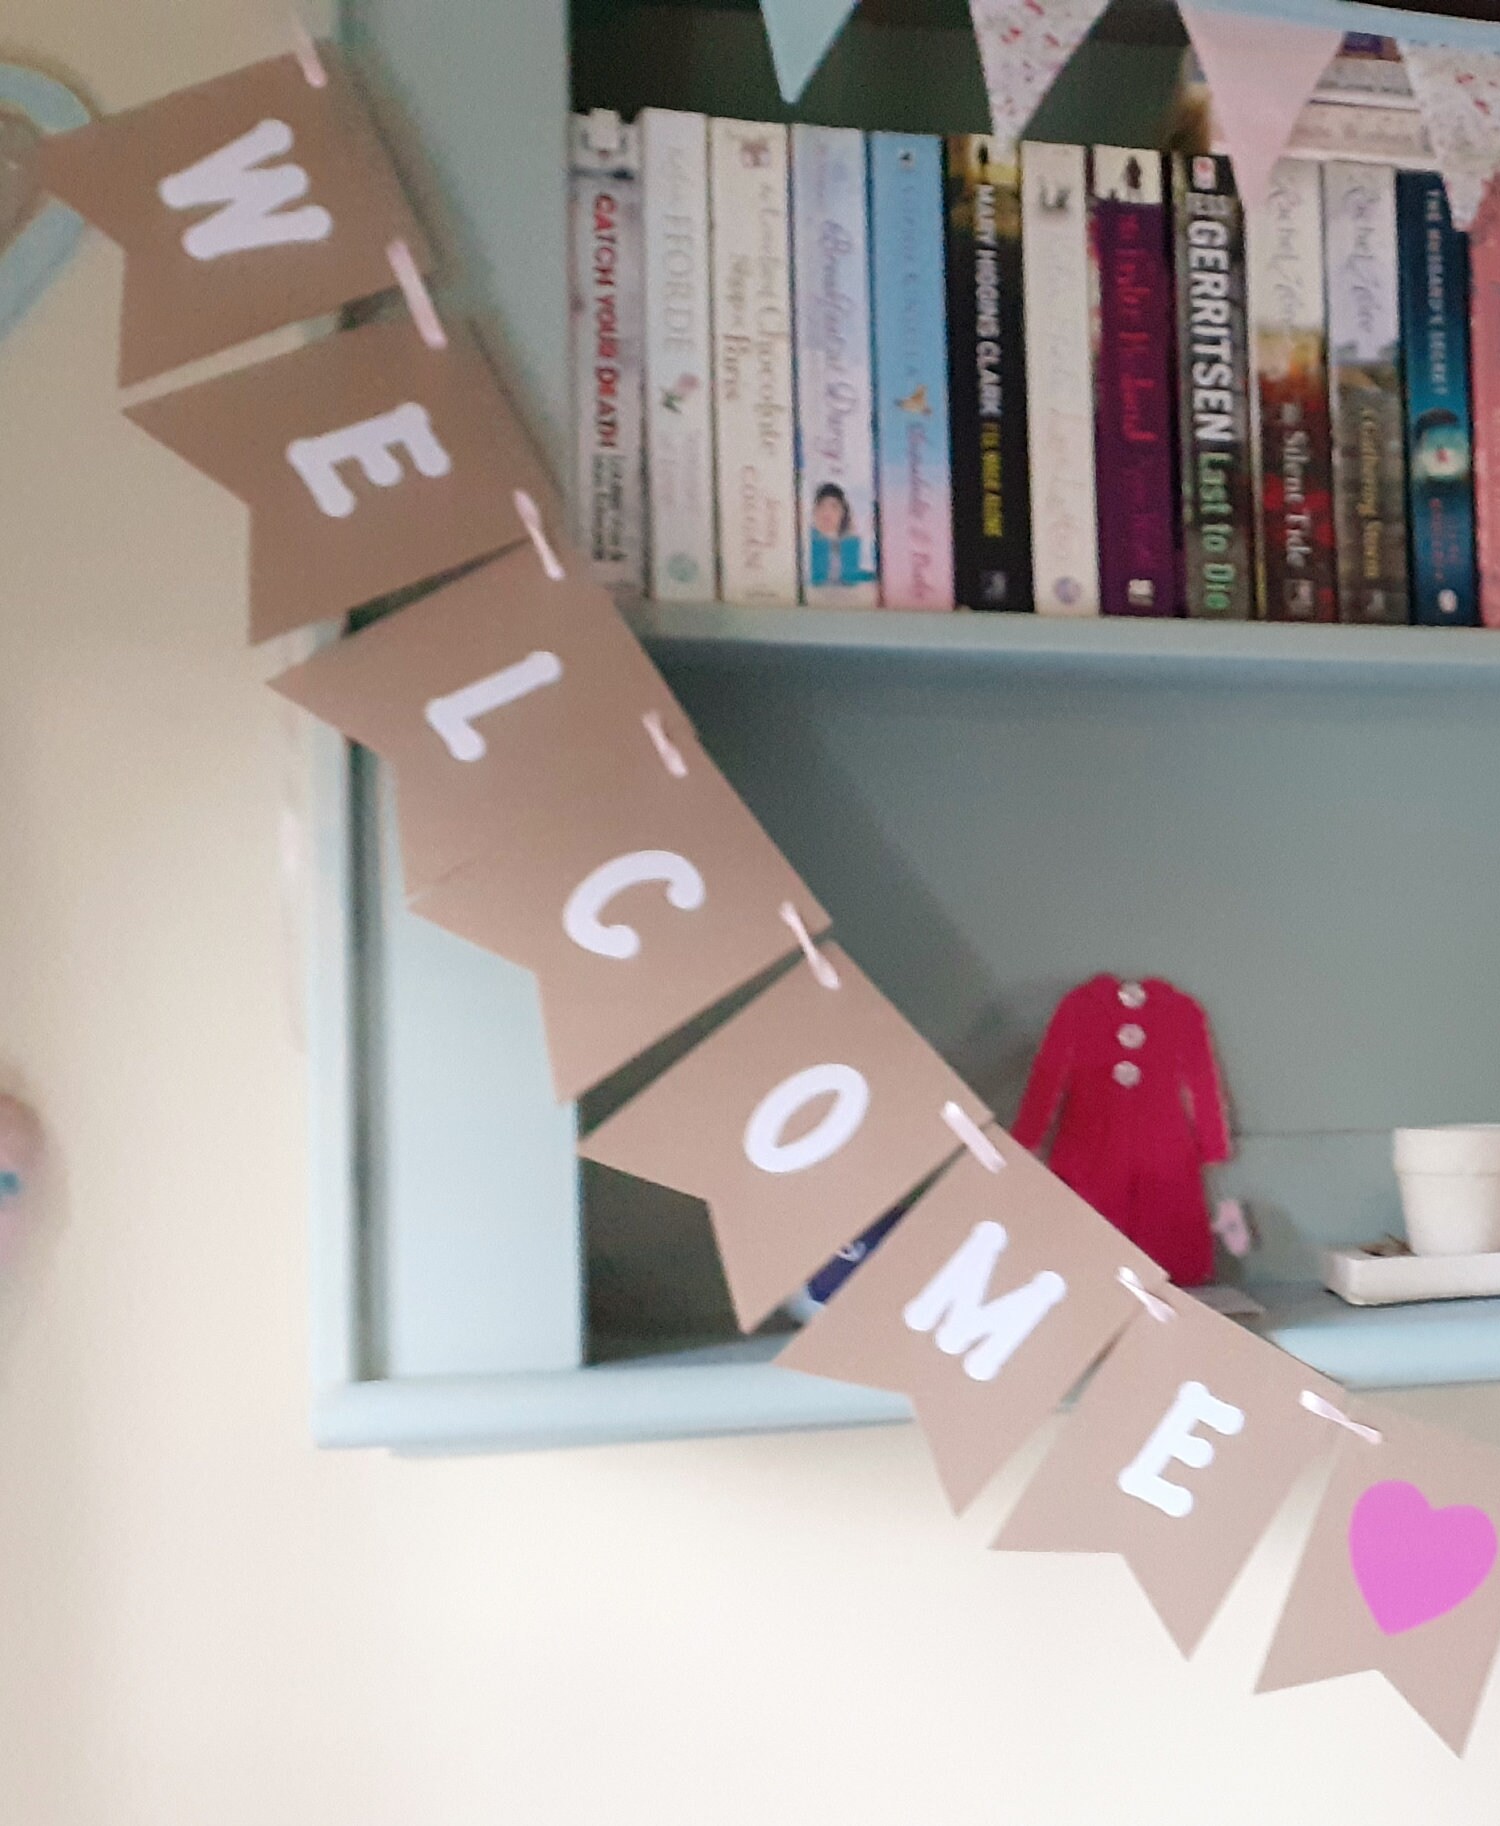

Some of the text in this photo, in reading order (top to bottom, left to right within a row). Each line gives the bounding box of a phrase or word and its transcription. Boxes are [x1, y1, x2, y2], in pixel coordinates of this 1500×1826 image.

[593, 194, 618, 288] CATCH
[661, 213, 697, 354] FFORDE
[594, 295, 619, 359] YOUR
[976, 183, 1002, 417] MARY HIGGINS CLARK
[1187, 219, 1242, 444] GERRITSEN
[593, 365, 620, 450] DEATH
[722, 334, 752, 402] Paris
[752, 306, 790, 455] Chocolate
[1428, 331, 1448, 397] SECRET
[1283, 430, 1311, 503] Silent
[1355, 420, 1380, 517] Gathering
[1198, 451, 1240, 609] Last to Die
[1284, 508, 1312, 569] Tide
[1362, 520, 1383, 579] Storm
[159, 118, 1245, 1518] WELCOME
